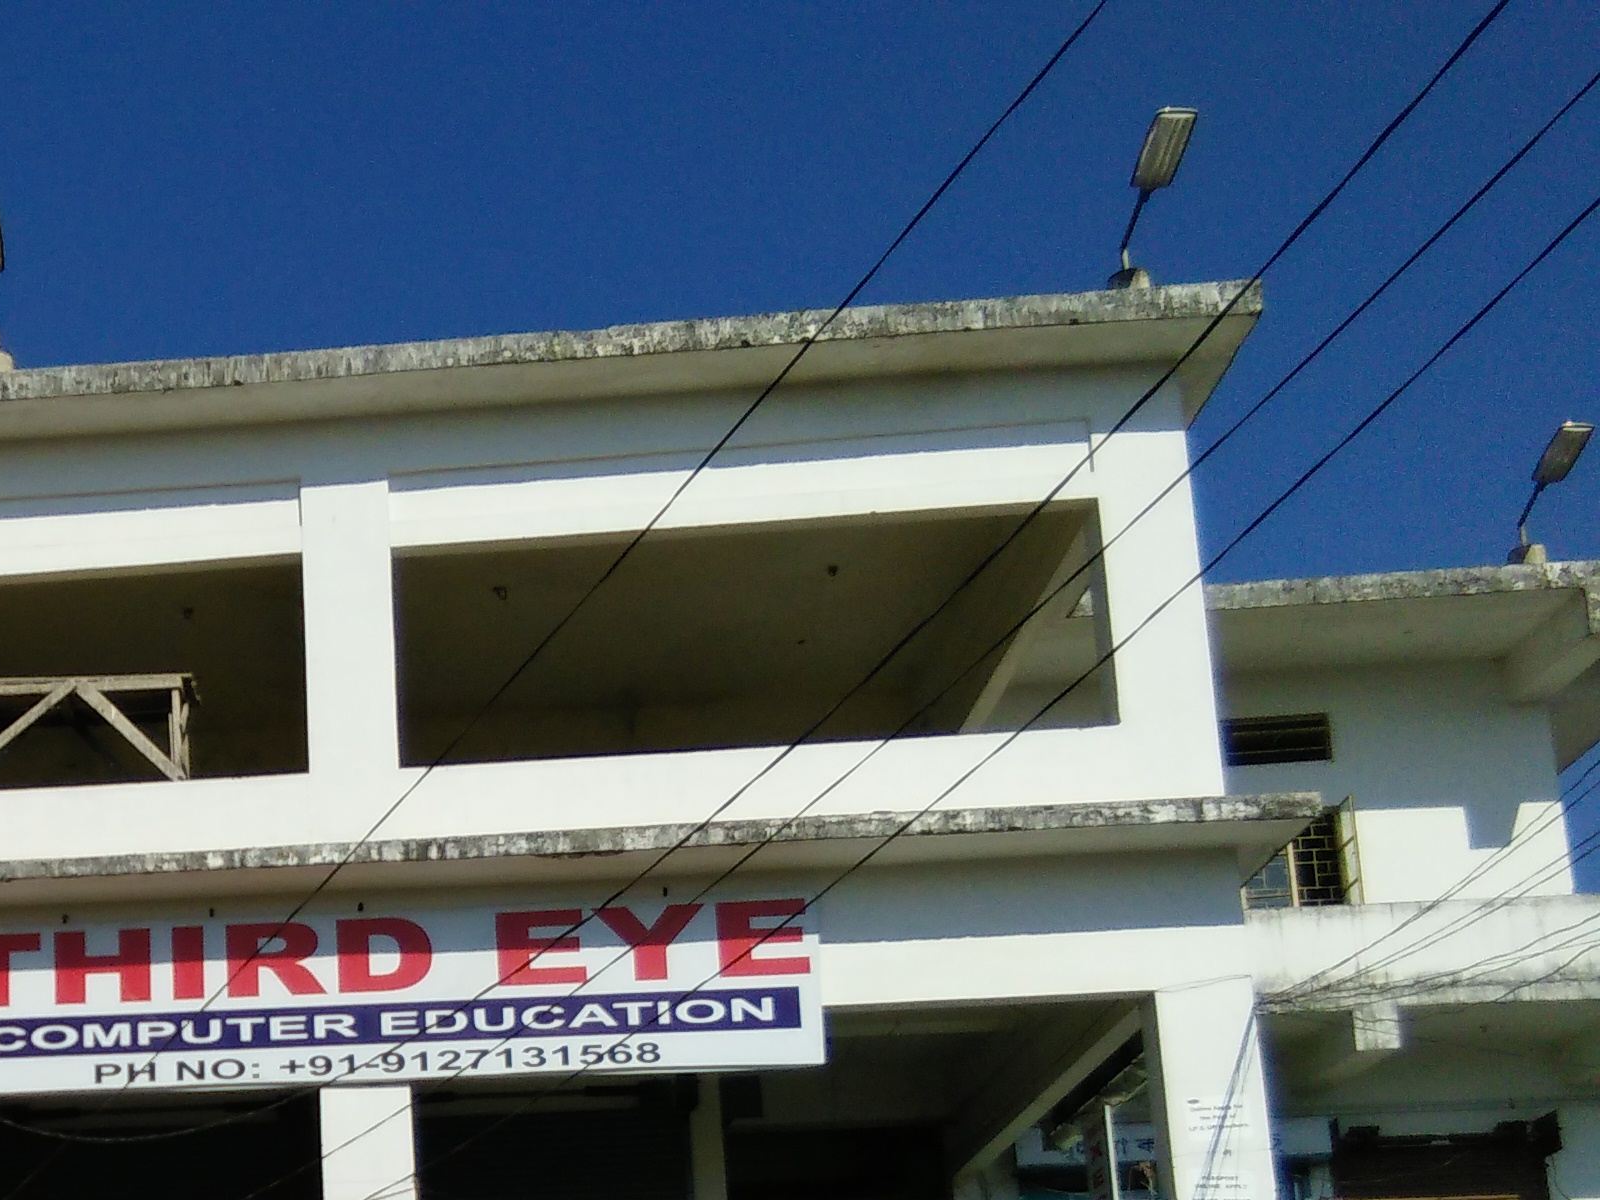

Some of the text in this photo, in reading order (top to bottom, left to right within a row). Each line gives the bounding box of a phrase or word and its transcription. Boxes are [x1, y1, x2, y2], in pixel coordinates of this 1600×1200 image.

[496, 899, 810, 986] EYE
[380, 998, 775, 1036] EDUCATION
[95, 1043, 660, 1083] PH NO: +91-9127131568
